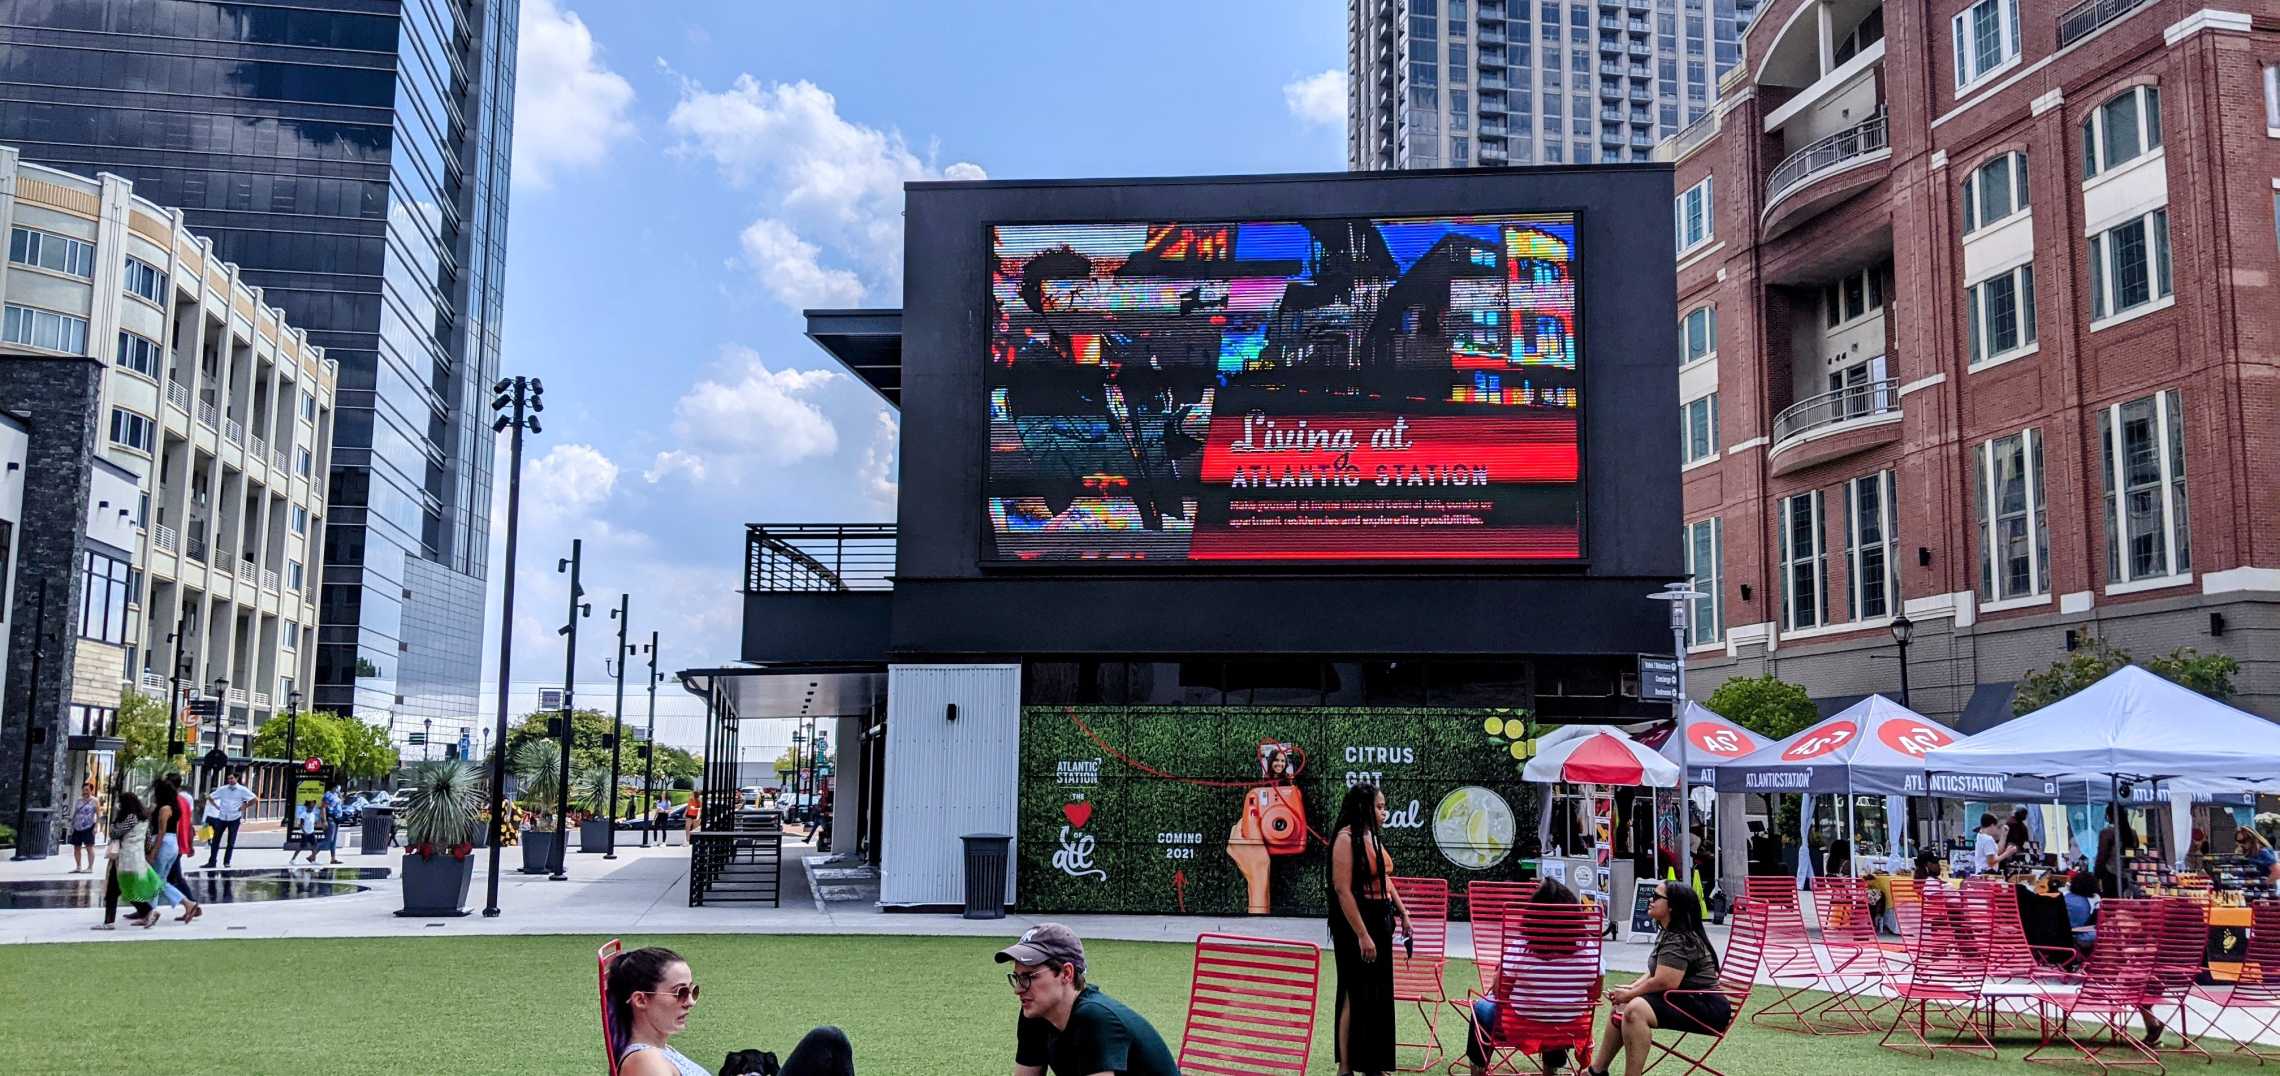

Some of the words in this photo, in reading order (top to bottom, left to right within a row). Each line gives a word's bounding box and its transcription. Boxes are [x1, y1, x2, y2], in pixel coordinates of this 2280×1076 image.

[1231, 409, 1359, 468] Living
[1371, 416, 1413, 451] at
[1231, 465, 1360, 488] ATLANTIC
[1376, 463, 1488, 487] STATION
[1345, 746, 1414, 764] CITRUS
[1056, 761, 1098, 772] ATLANTIC
[1056, 772, 1098, 784] STATION
[1345, 771, 1382, 789] GOT
[1746, 771, 1811, 788] ATLANTICSTATION
[1382, 800, 1424, 828] eal
[1157, 833, 1203, 844] COMING
[1166, 848, 1194, 859] 2021
